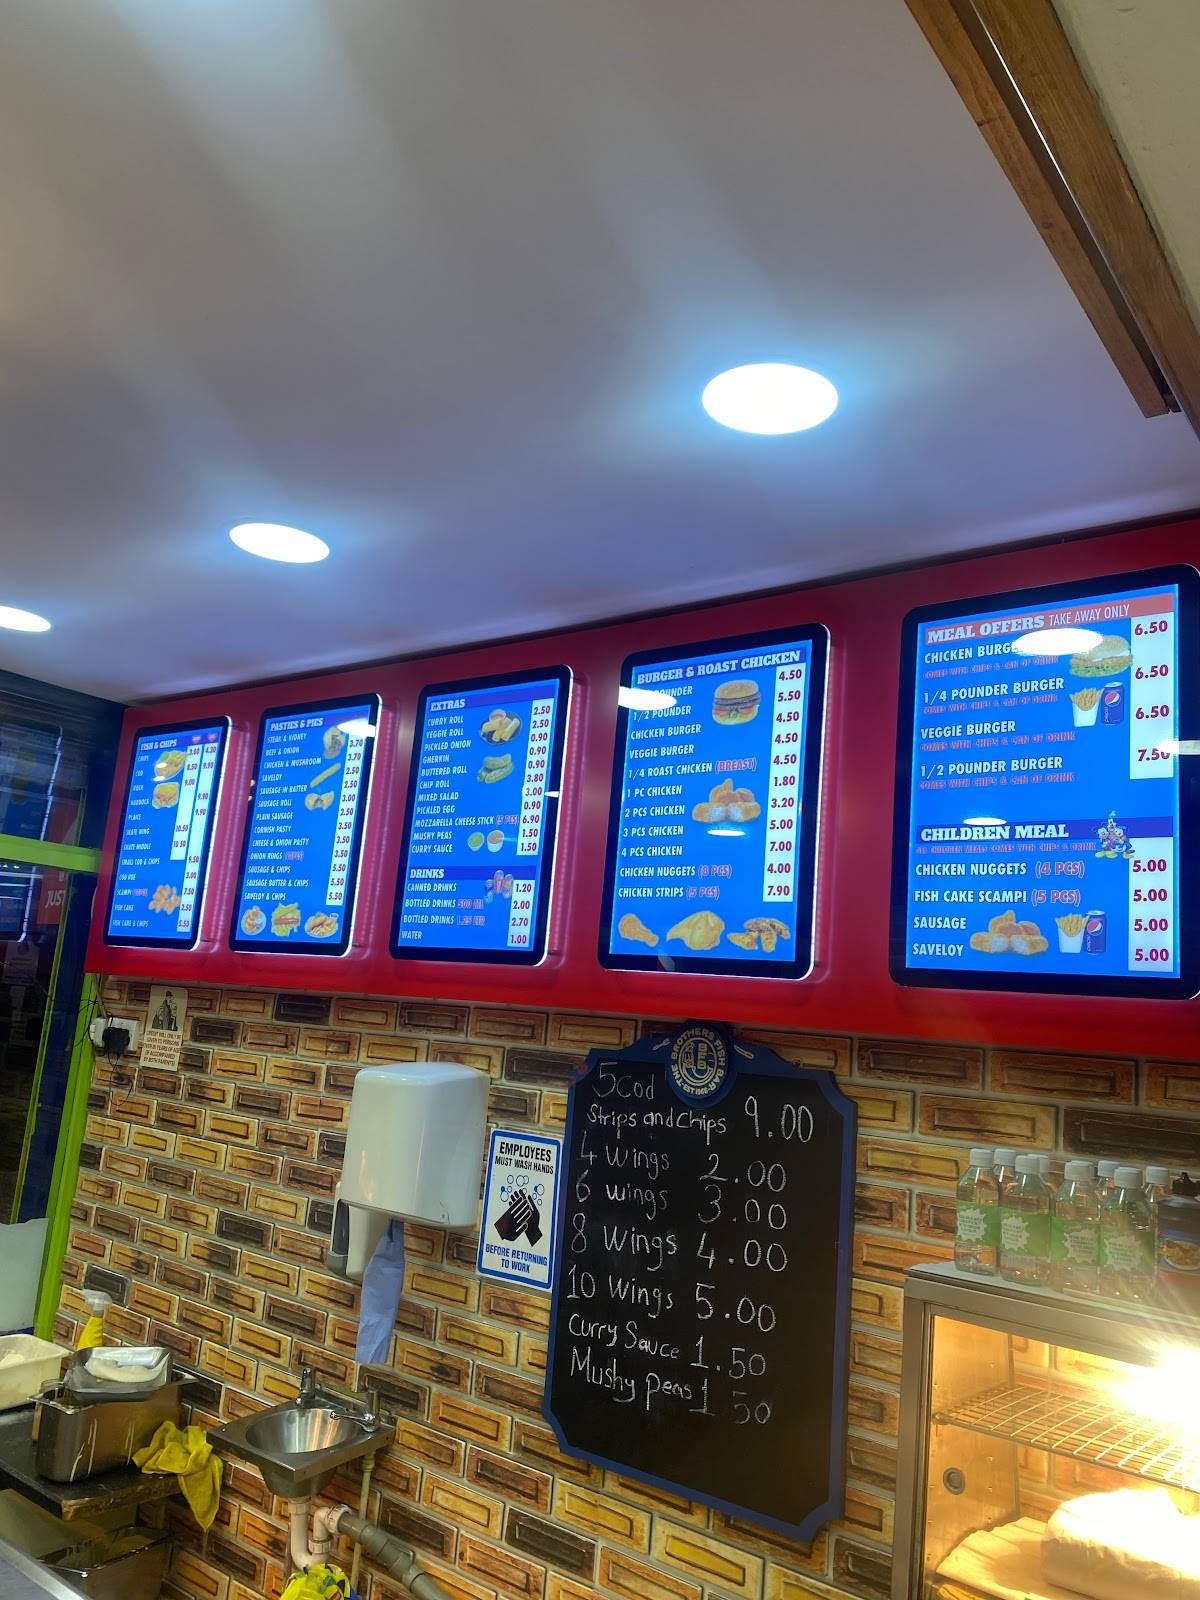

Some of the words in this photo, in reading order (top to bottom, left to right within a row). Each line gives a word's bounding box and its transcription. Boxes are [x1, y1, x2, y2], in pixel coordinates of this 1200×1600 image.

[928, 625, 975, 644] MEAL
[980, 616, 1044, 635] OFFERS
[1050, 614, 1072, 626] TAKE
[1075, 609, 1102, 623] AWAY
[1104, 605, 1130, 619] ONLY
[1134, 620, 1168, 636] 6.50
[924, 648, 973, 664] CHICKEN
[637, 669, 683, 684] BURGER
[686, 667, 694, 677] &
[698, 660, 738, 676] ROAST
[741, 650, 800, 669] CHICKEN
[1135, 664, 1169, 680] 6.50
[778, 670, 802, 681] 4.50
[778, 691, 800, 702] 5.50
[924, 691, 947, 705] 1/4
[952, 683, 1008, 700] POUNDER
[1013, 678, 1064, 694] BURGER
[431, 699, 465, 712] EXTRAS
[533, 705, 550, 715] 2.50
[633, 710, 649, 722] 1/2
[652, 705, 691, 719] POUNDER
[776, 712, 799, 723] 4.50
[1136, 705, 1169, 719] 6.50
[270, 720, 299, 732] PASTIES
[306, 717, 324, 728] PIES
[428, 717, 447, 726] CURRY
[450, 716, 464, 724] ROLL
[532, 719, 549, 728] 2.50
[426, 729, 447, 739] VEGGIE
[450, 728, 464, 736] ROLL
[631, 728, 664, 740] CHICKEN
[668, 724, 701, 736] BURGER
[921, 723, 962, 740] VEGGIE
[967, 721, 1016, 735] BURGER
[775, 733, 798, 744] 4.50
[629, 748, 658, 759] VEGGIE
[661, 745, 694, 756] BURGER
[528, 760, 545, 769] 0.90
[773, 755, 796, 765] 4.50
[421, 768, 450, 776] BUTTERED
[453, 766, 467, 774] ROLL
[629, 770, 644, 780] 1/4
[648, 766, 673, 777] ROAST
[677, 762, 712, 774] CHICKEN
[716, 758, 756, 773] (BREAST)
[921, 764, 944, 780] 1/2
[949, 760, 1006, 775] POUNDER
[1011, 757, 1063, 771] BURGER
[527, 774, 543, 782] 3.80
[774, 776, 795, 786] 1.80
[420, 781, 433, 789] CHIP
[627, 789, 630, 798] 1
[634, 788, 644, 797] PC
[647, 785, 682, 796] CHICKEN
[771, 798, 794, 808] 3.20
[625, 809, 629, 817] 2
[633, 808, 647, 816] PCS
[650, 805, 685, 816] CHICKEN
[769, 819, 793, 830] 5.00
[623, 829, 628, 837] 3
[631, 828, 645, 836] PCS
[649, 826, 684, 836] CHICKEN
[921, 825, 1010, 842] CHILDREN
[1015, 824, 1069, 839] MEAL
[621, 848, 626, 857] 4
[630, 848, 644, 856] PCS
[647, 846, 682, 856] CHICKEN
[769, 841, 792, 851] 7.00
[248, 865, 269, 873] SAUSAGE
[276, 865, 291, 873] CHIPS
[332, 864, 346, 872] 5.50
[620, 867, 654, 877] CHICKEN
[657, 866, 695, 876] NUGGETS
[712, 865, 732, 878] PCS)
[767, 863, 790, 874] 4.00
[915, 863, 966, 876] CHICKEN
[970, 863, 1027, 875] NUGGETS
[1035, 861, 1050, 878] (4
[1055, 861, 1085, 878] PCS)
[1132, 860, 1167, 872] 5.00
[410, 869, 444, 878] DRINKS
[408, 883, 431, 892] CANNED
[433, 883, 456, 891] DRINKS
[516, 884, 531, 892] 1.20
[618, 887, 652, 897] CHICKEN
[656, 887, 684, 897] STRIPS
[700, 886, 719, 899] PCS)
[767, 886, 790, 895] 7.90
[915, 891, 938, 902] FISH
[944, 891, 973, 902] CAKE
[979, 891, 1027, 903] SCAMPI
[1031, 890, 1046, 906] (5
[1051, 890, 1080, 906] PCS)
[1133, 889, 1167, 902] 5.00
[913, 917, 967, 929] SAUSAGE
[1134, 919, 1168, 931] 5.00
[401, 931, 422, 939] WATER
[511, 935, 527, 944] 1.00
[913, 944, 963, 956] SAVELOY
[1135, 949, 1169, 961] 5.00
[714, 1039, 725, 1065] FISH
[587, 1103, 636, 1140] Strips
[744, 1096, 813, 1142] 9.00
[500, 1142, 551, 1162] EMPLOYEES
[495, 1156, 512, 1167] MUST
[514, 1159, 532, 1170] WASH
[534, 1163, 554, 1175] HANDS
[577, 1131, 598, 1166] 4
[700, 1153, 786, 1192] 2.00
[575, 1169, 591, 1202] 6
[698, 1184, 786, 1230] 3.00
[571, 1212, 587, 1253] 8
[603, 1225, 678, 1271] Wings
[697, 1232, 788, 1272] 4.00
[485, 1243, 510, 1258] BEFORE
[512, 1249, 548, 1266] RETURNING
[501, 1259, 510, 1269] TO
[512, 1261, 530, 1273] WORK
[567, 1264, 596, 1299] 10
[609, 1274, 673, 1318] Wings
[696, 1282, 776, 1332] 5.00
[568, 1313, 618, 1347] Curry
[624, 1320, 680, 1359] Sauce
[690, 1336, 766, 1379] 1.50
[570, 1346, 636, 1402] Mushy
